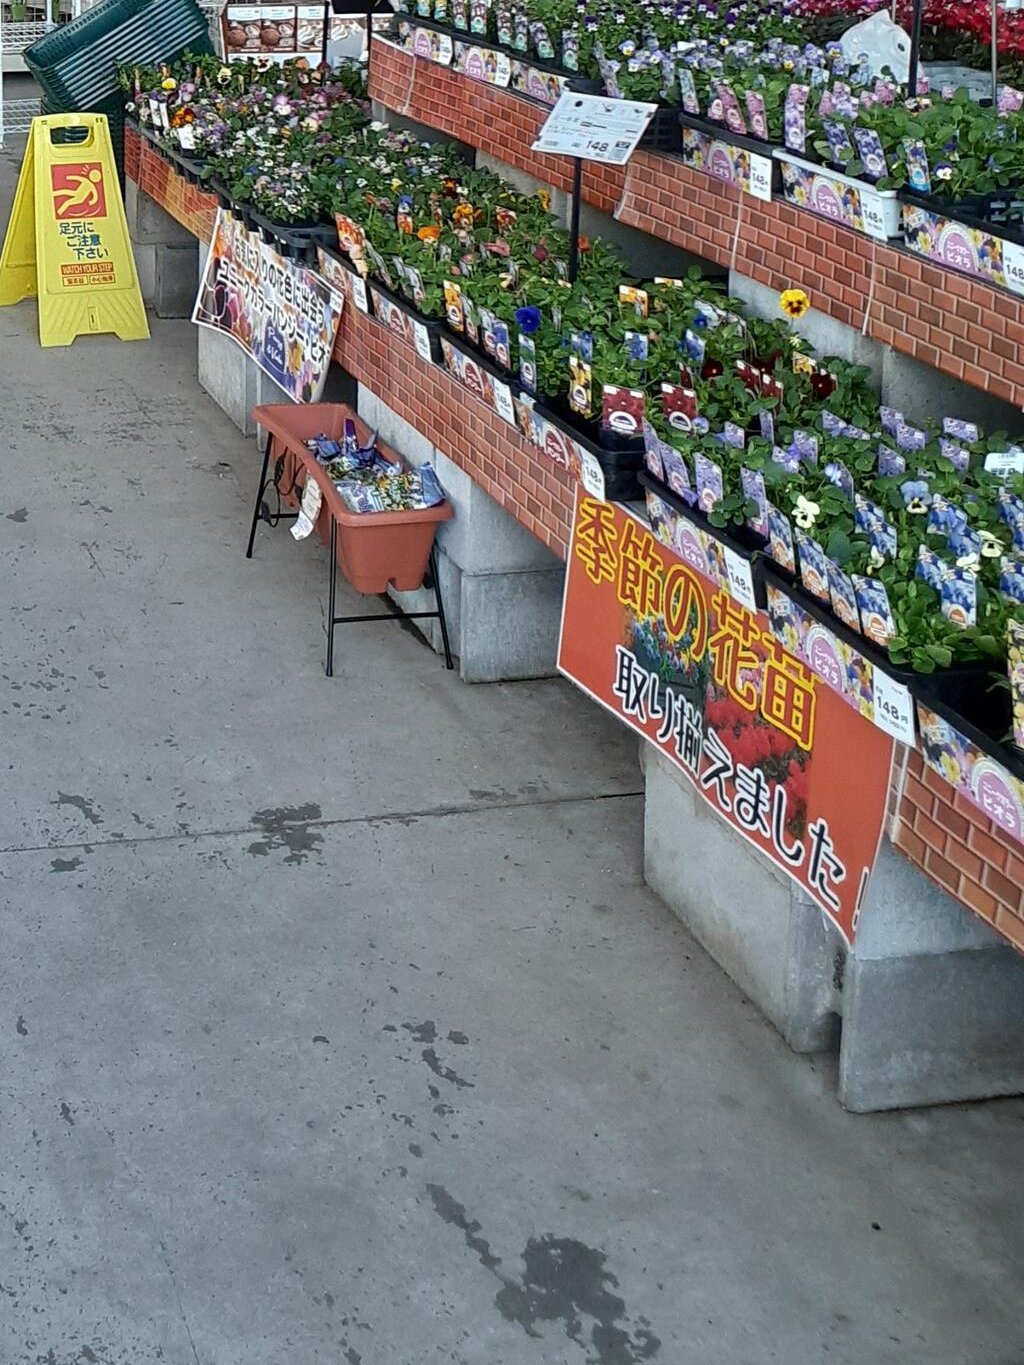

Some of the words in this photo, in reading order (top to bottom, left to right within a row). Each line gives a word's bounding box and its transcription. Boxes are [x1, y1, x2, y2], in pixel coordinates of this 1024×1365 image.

[585, 140, 610, 153] 148
[59, 221, 95, 235] 足元に
[67, 234, 102, 247] ご注意
[72, 247, 109, 260] 下さい
[947, 250, 971, 268] ビオラ
[62, 264, 82, 274] WATCH
[83, 264, 98, 273] YOUR
[99, 263, 113, 272] STEP
[814, 656, 839, 684] ビオラ
[876, 695, 909, 725] 148円
[983, 793, 1016, 828] ビオラ
